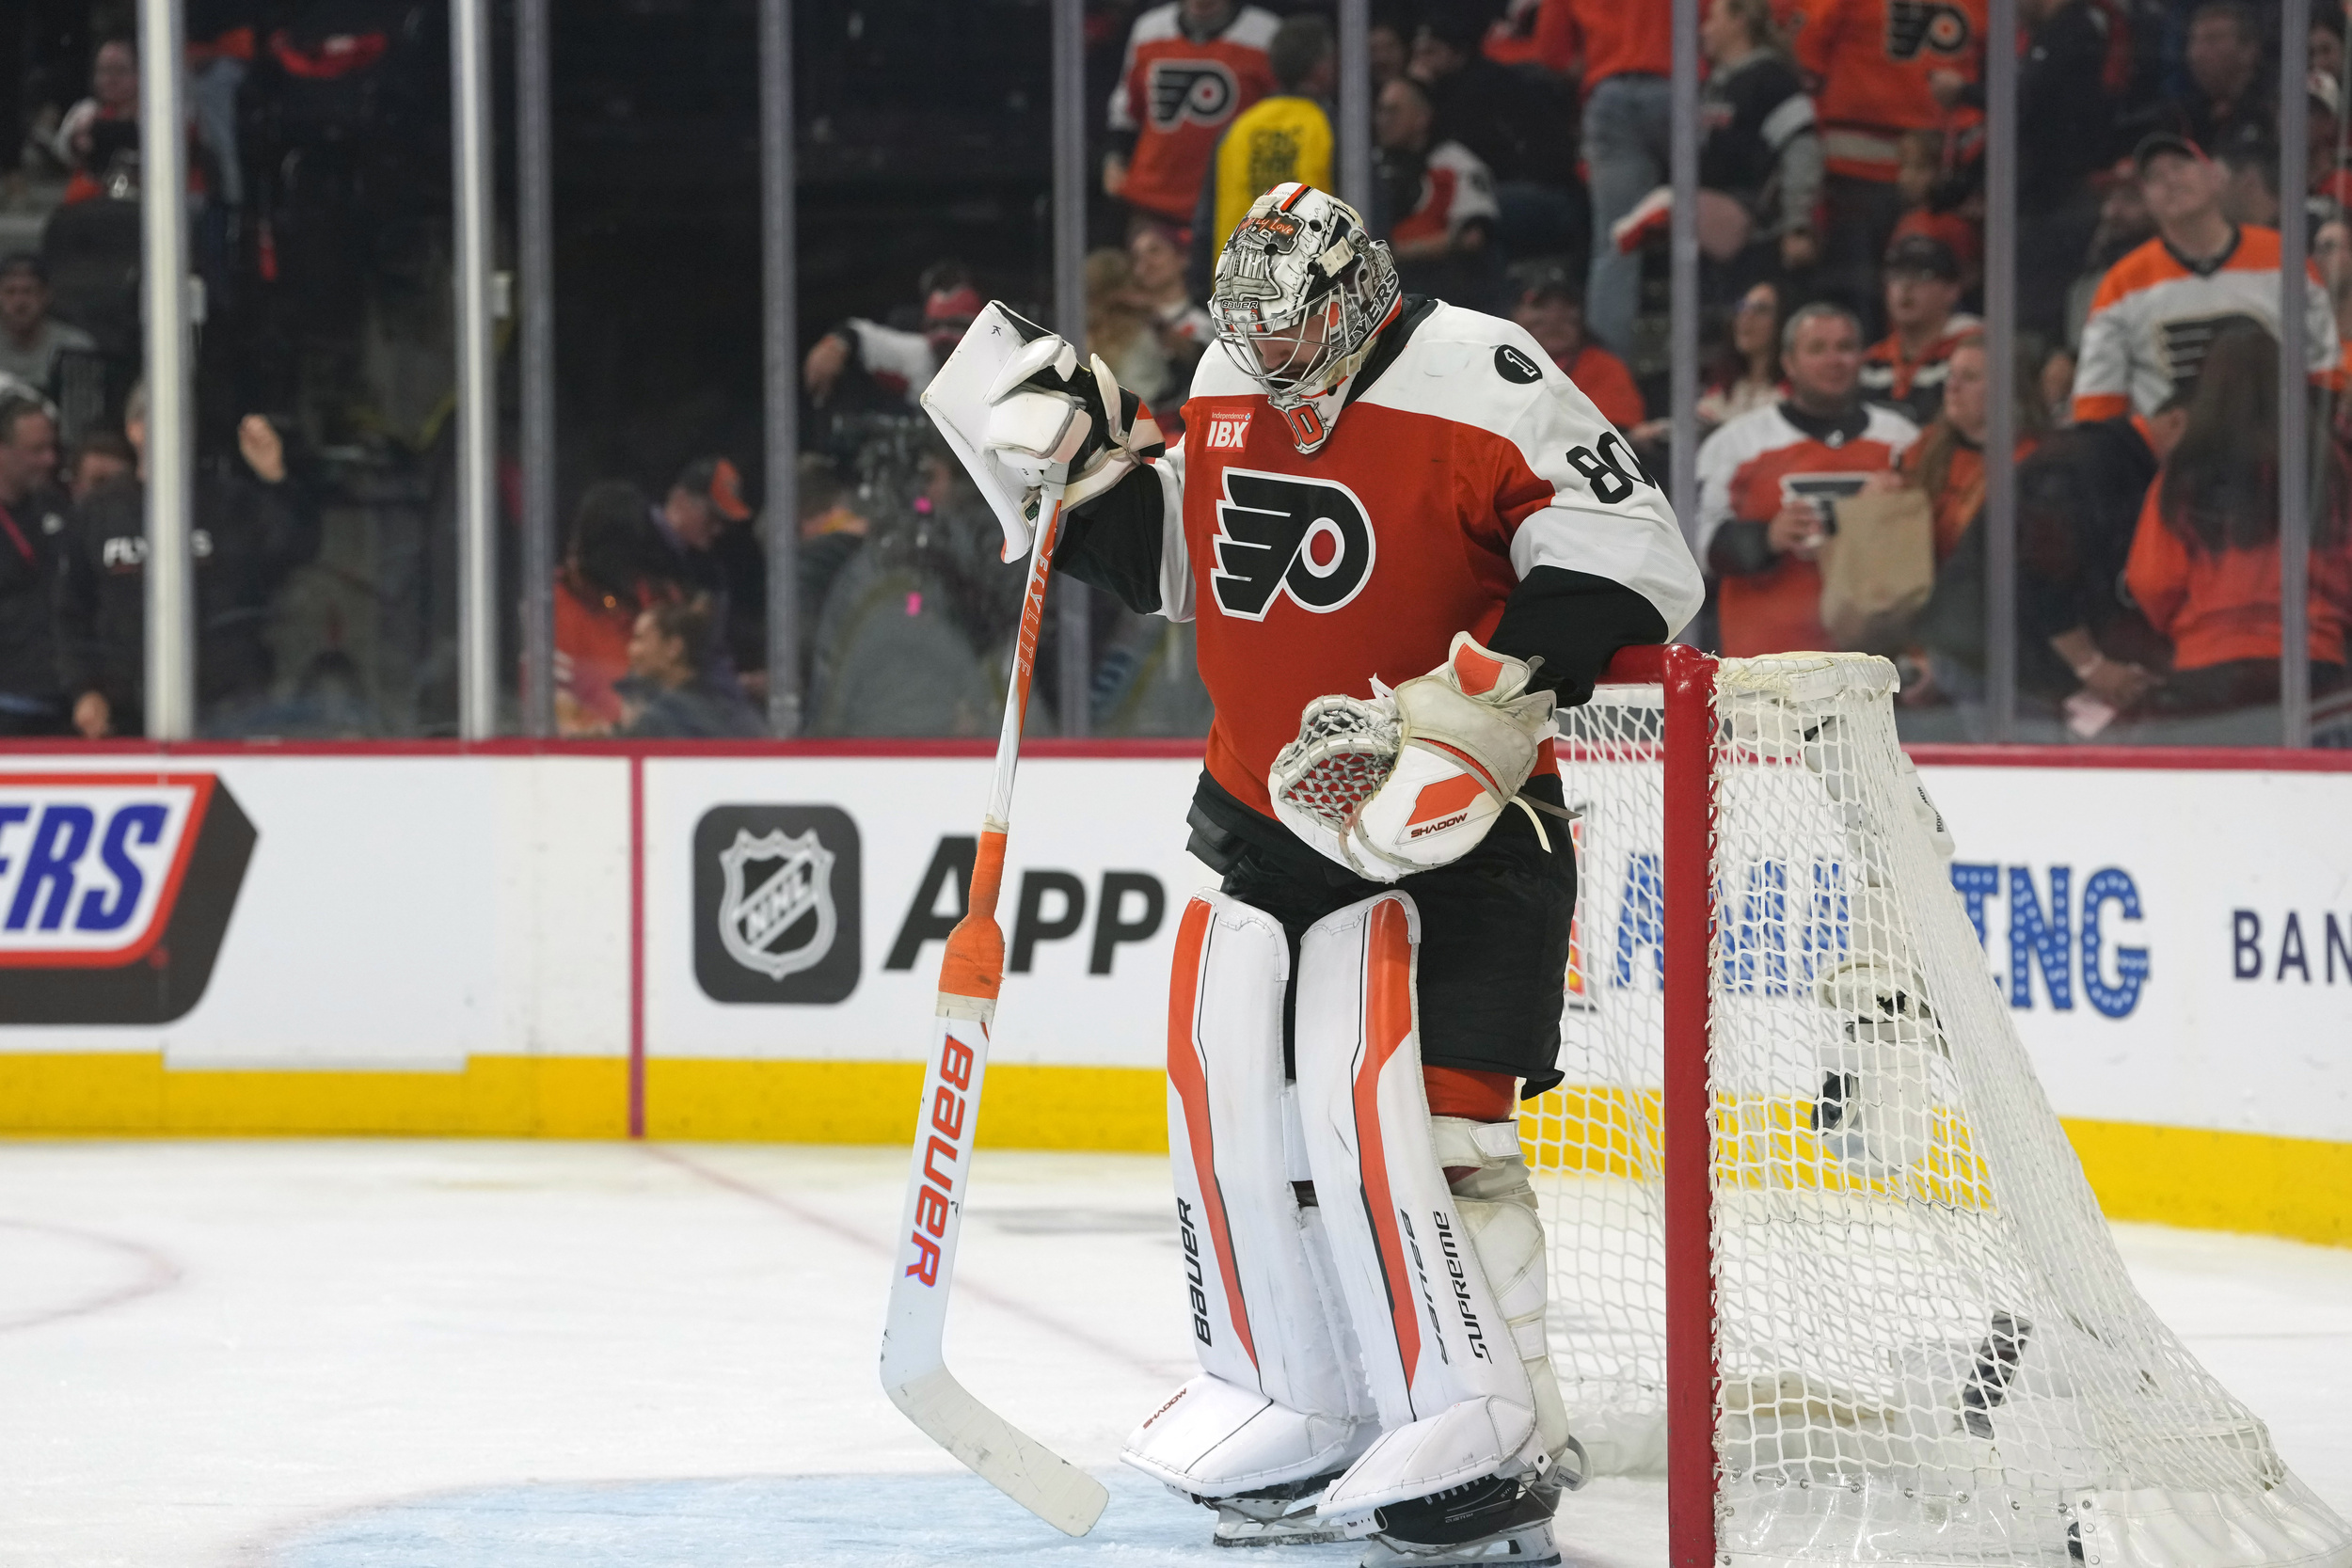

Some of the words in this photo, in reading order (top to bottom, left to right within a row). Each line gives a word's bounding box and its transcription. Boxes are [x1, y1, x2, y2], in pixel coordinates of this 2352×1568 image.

[1221, 300, 1259, 310] BAUER
[1206, 420, 1249, 449] IBX
[1211, 411, 1245, 420] Independence
[1565, 431, 1657, 504] 80
[1410, 812, 1470, 839] SHADOW
[744, 867, 811, 942] NHL
[903, 1031, 975, 1289] BAUER
[1177, 1196, 1213, 1348] BAUER
[1432, 1211, 1493, 1365] SUPREME
[1142, 1387, 1187, 1430] SHADOW
